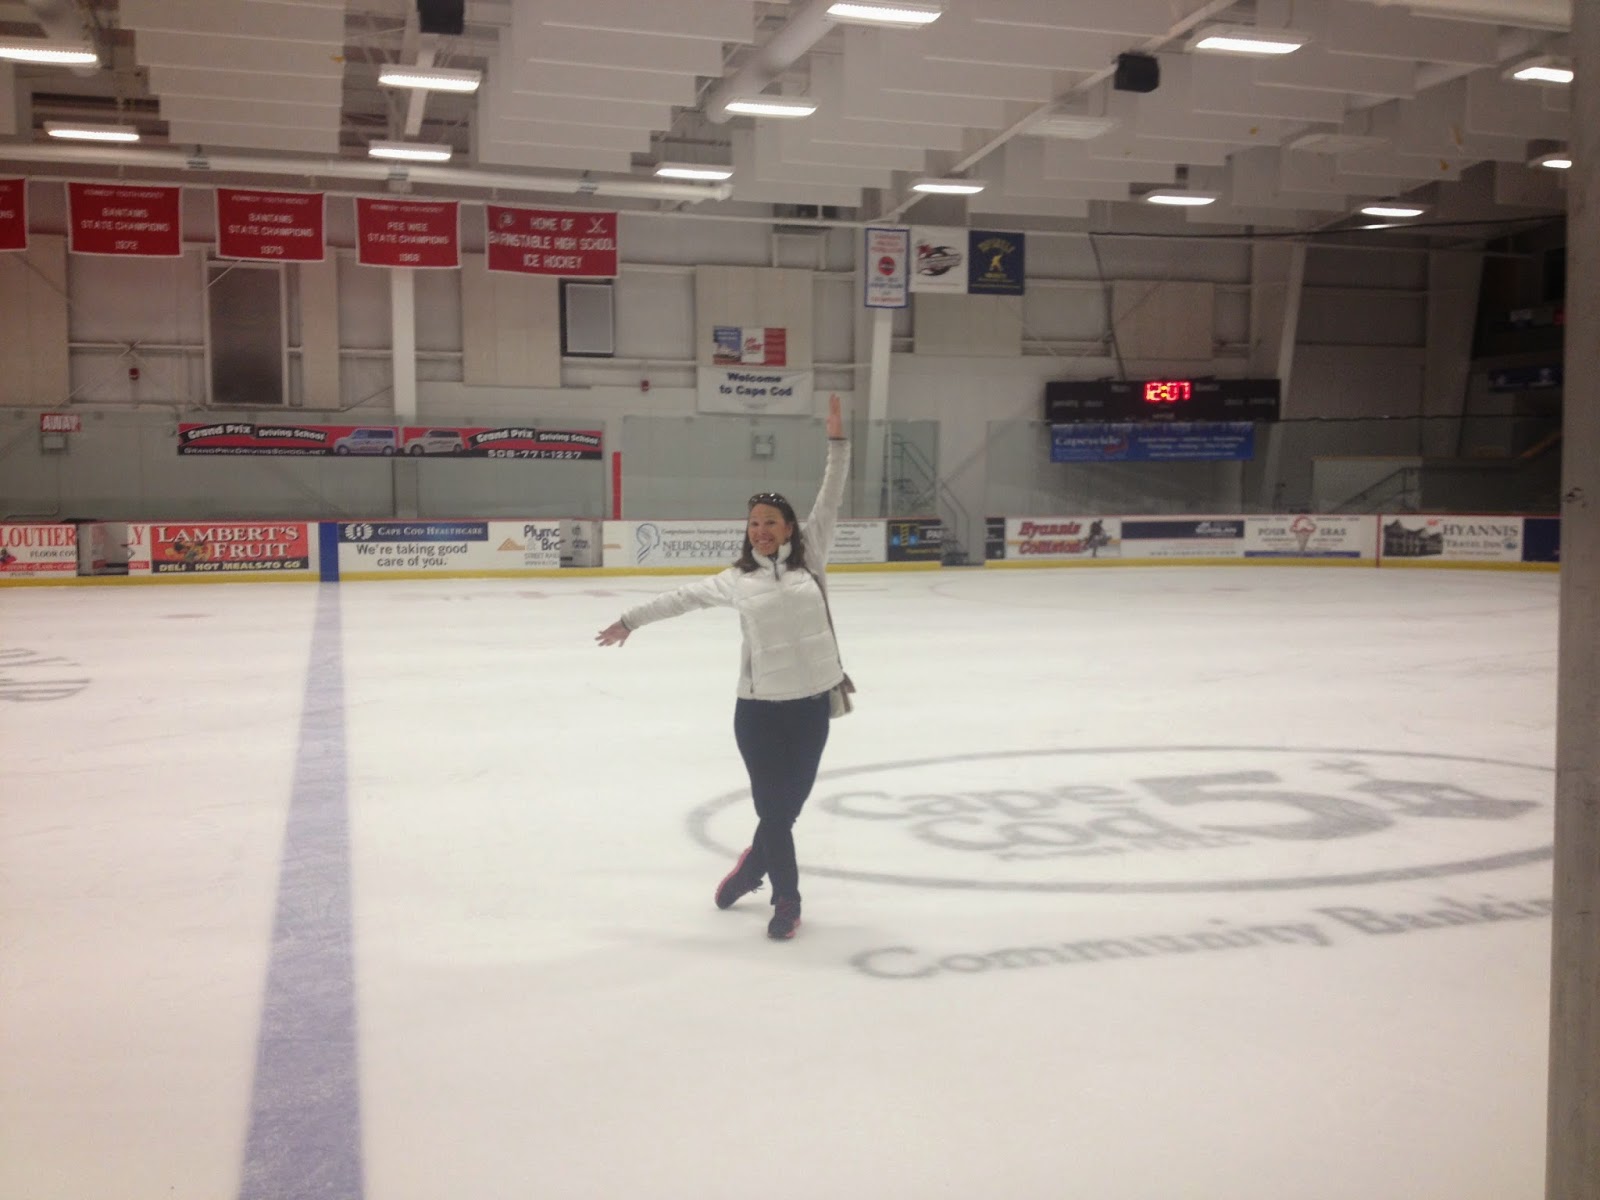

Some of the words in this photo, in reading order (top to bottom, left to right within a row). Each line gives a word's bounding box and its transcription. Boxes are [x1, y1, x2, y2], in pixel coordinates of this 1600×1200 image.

[102, 207, 149, 218] BANTAMS
[248, 213, 294, 224] BANTAMS
[80, 219, 113, 231] STATE
[114, 221, 171, 233] CHAMPIONS
[387, 221, 406, 231] PEE
[408, 222, 429, 232] WEE
[530, 217, 558, 231] HOME
[560, 218, 575, 231] OF
[228, 225, 260, 235] STATE
[261, 226, 315, 238] CHAMPIONS
[367, 233, 398, 243] STATE
[399, 234, 449, 245] CHAMPIONS
[488, 230, 551, 249] BARNSTABLE
[554, 236, 576, 250] HIGH
[580, 237, 617, 251] SCHOOL
[523, 254, 540, 268] ICE
[543, 255, 583, 269] HOCKEY
[727, 372, 781, 383] Welcome
[719, 385, 732, 395] to
[736, 386, 766, 397] Cape
[770, 386, 793, 396] Cod
[1145, 382, 1190, 401] 12:07
[42, 415, 79, 431] AWAY
[187, 424, 224, 440] Grand
[225, 424, 251, 435] Prix
[258, 429, 292, 438] Driving
[293, 430, 327, 441] School
[476, 429, 509, 443] Grand
[510, 428, 533, 439] Prix
[539, 431, 569, 442] Driving
[570, 433, 599, 446] School
[488, 449, 582, 459] 508-771-1227
[158, 525, 300, 544] LAMBERT'S
[378, 526, 401, 536] CAPE
[403, 526, 424, 536] COD
[426, 525, 483, 536] HEALTHCARE
[1443, 524, 1518, 536] HYANNIS
[212, 542, 292, 561] FRUIT
[356, 544, 392, 555] We're
[396, 543, 435, 558] taking
[438, 543, 468, 557] good
[159, 563, 187, 572] DELI
[195, 563, 220, 571] HOT
[284, 560, 301, 569] GO
[377, 556, 404, 567] care
[407, 554, 420, 566] of
[422, 556, 448, 568] you.
[819, 783, 1138, 820] Cape
[1132, 769, 1396, 841] 5
[909, 807, 1212, 852] Cod
[848, 916, 1334, 980] Community
